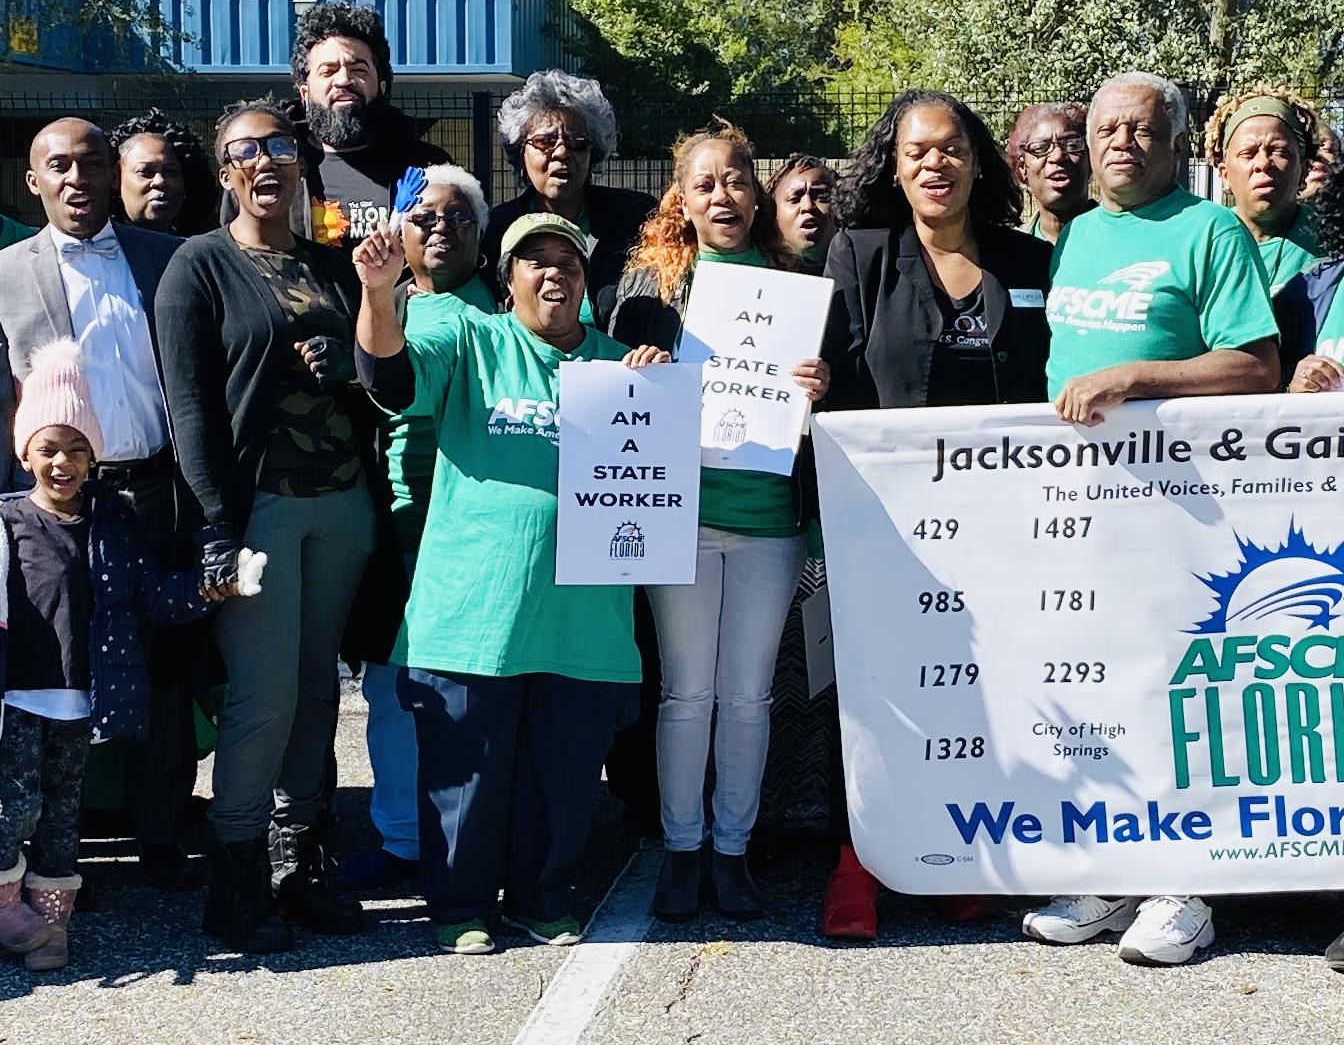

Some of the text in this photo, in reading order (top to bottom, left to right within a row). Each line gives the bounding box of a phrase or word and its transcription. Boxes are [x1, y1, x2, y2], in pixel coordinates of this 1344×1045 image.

[350, 206, 389, 223] FLOR
[757, 288, 763, 300] I
[735, 311, 773, 326] AM
[740, 335, 756, 348] A
[709, 355, 778, 377] STATE
[628, 384, 634, 399] I
[488, 397, 560, 427] AFS
[610, 411, 651, 426] AM
[488, 425, 502, 435] We
[504, 424, 534, 435] Make
[620, 438, 640, 453] A
[931, 429, 1192, 485] Jacksonville
[1208, 428, 1248, 462] &
[592, 465, 666, 481] STATE
[1042, 486, 1078, 502] The
[1086, 480, 1154, 501] United
[1158, 479, 1226, 498] Voices,
[1231, 477, 1314, 495] Families
[1320, 475, 1338, 492] &
[574, 492, 683, 508] WORKER
[912, 518, 959, 540] 429
[1033, 516, 1093, 539] 1487
[918, 590, 965, 614] 985
[1040, 590, 1095, 611] 1781
[919, 663, 980, 688] 1279
[1043, 661, 1106, 684] 2293
[1032, 722, 1126, 740] City of High
[924, 736, 985, 761] 1328
[1054, 743, 1109, 761] Springs
[944, 801, 1043, 845] We
[1060, 800, 1213, 844] Make
